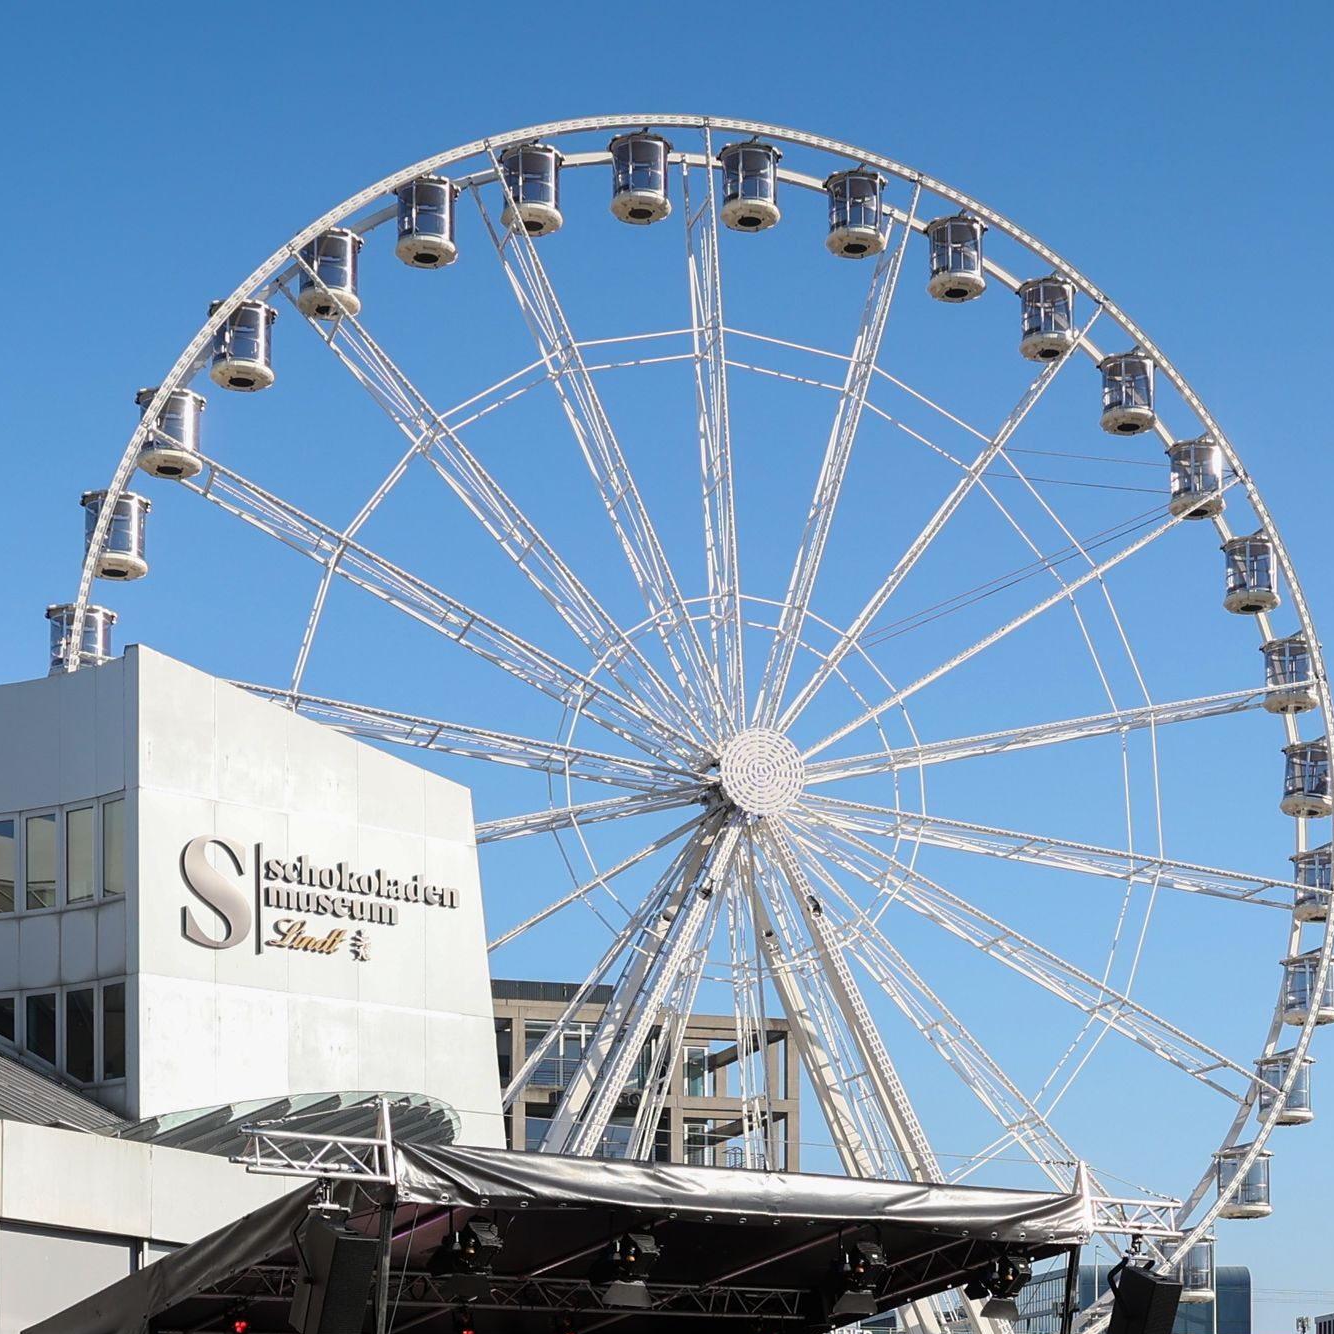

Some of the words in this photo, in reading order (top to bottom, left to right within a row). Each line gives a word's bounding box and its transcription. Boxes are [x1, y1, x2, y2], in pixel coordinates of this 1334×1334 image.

[264, 856, 460, 908] schokoladen
[264, 885, 399, 926] museum
[266, 919, 346, 954] Lindt
